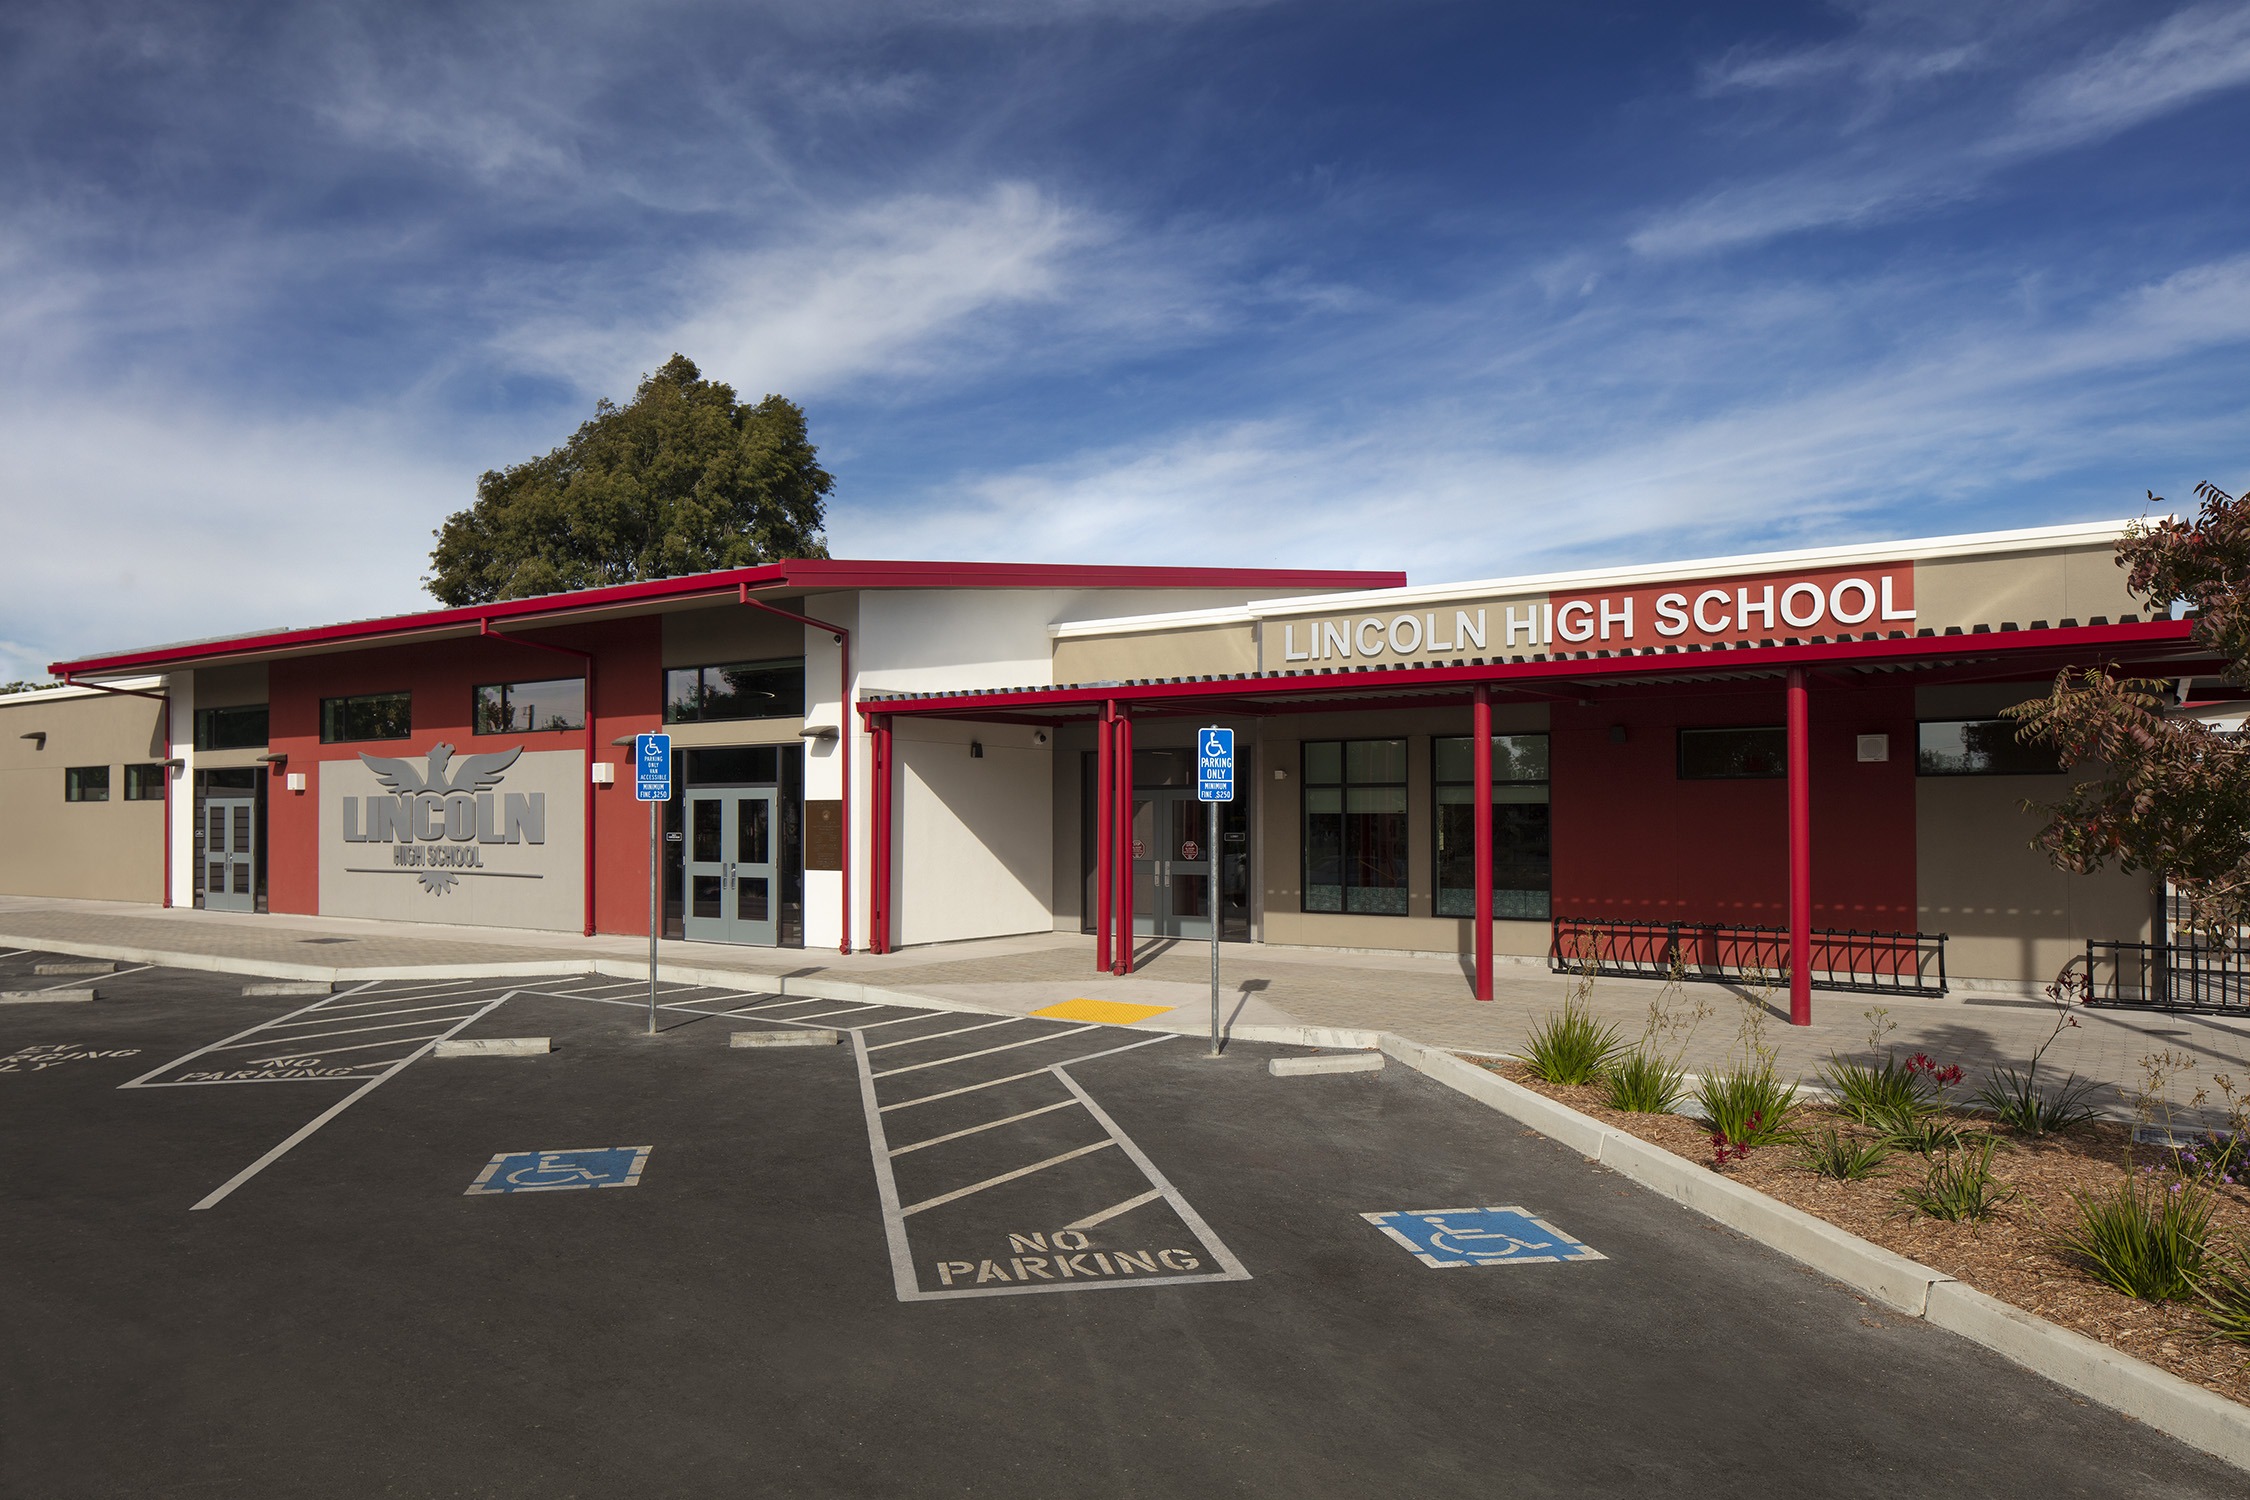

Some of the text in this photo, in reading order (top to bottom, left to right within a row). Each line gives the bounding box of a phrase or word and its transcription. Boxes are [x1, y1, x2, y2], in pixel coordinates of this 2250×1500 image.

[1285, 575, 1917, 662] LINCOLN HIGH SCHOOL
[1201, 757, 1232, 768] PARKING
[1207, 768, 1226, 779] ONLY
[653, 790, 667, 798] $250
[1201, 790, 1231, 799] FINE $250
[342, 792, 546, 845] LINCOLN
[393, 844, 484, 868] HIGH SCHOOL
[263, 1057, 322, 1069] NO
[174, 1067, 354, 1083] PARKING
[1006, 1230, 1091, 1253] NO
[936, 1248, 1201, 1286] PARKING
